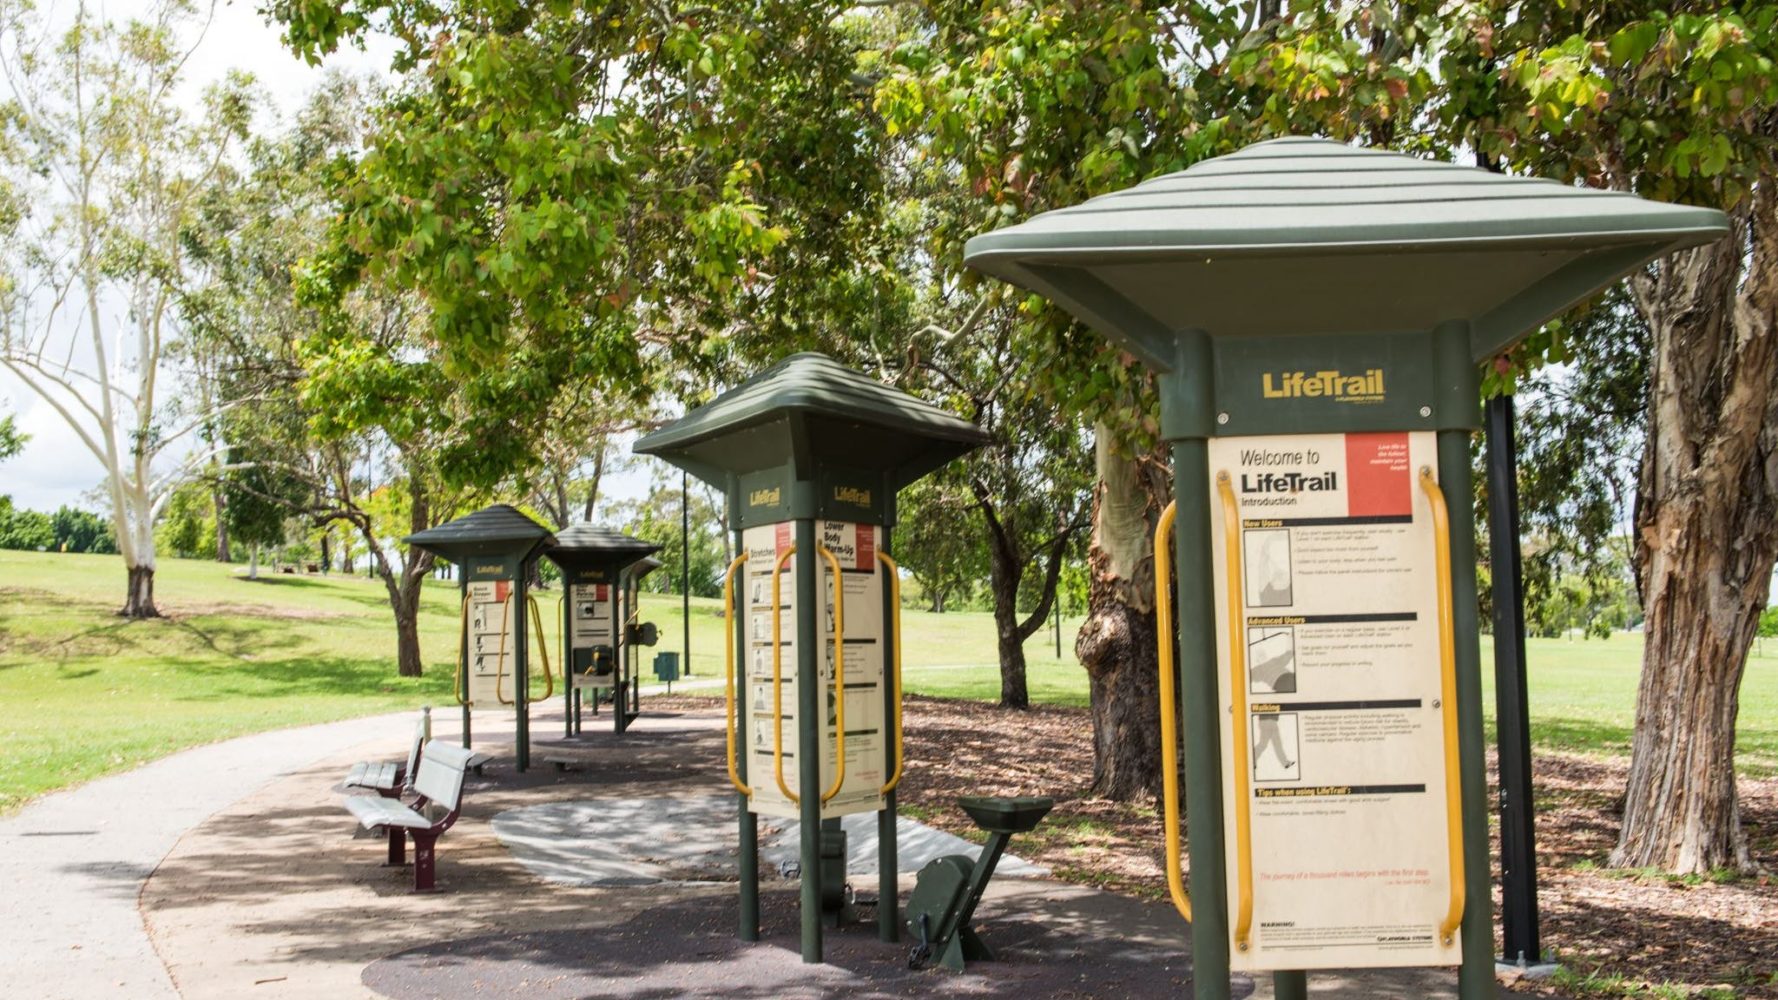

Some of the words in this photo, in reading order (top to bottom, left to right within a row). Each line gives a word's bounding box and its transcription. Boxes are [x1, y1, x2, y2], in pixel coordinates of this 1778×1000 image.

[1263, 369, 1385, 398] LifeTrail
[1241, 449, 1302, 466] Welcome
[1307, 449, 1320, 465] to
[1241, 472, 1337, 493] LifeTrail
[750, 487, 780, 506] LifeTrail
[834, 487, 871, 504] LifeTrail
[1241, 496, 1297, 507] Introduction
[1261, 518, 1283, 528] Users
[1248, 616, 1284, 626] Advanced
[1284, 615, 1306, 625] Users
[1251, 703, 1281, 713] Walking
[1256, 788, 1273, 798] Tips
[1274, 787, 1295, 796] when
[1295, 787, 1315, 797] using
